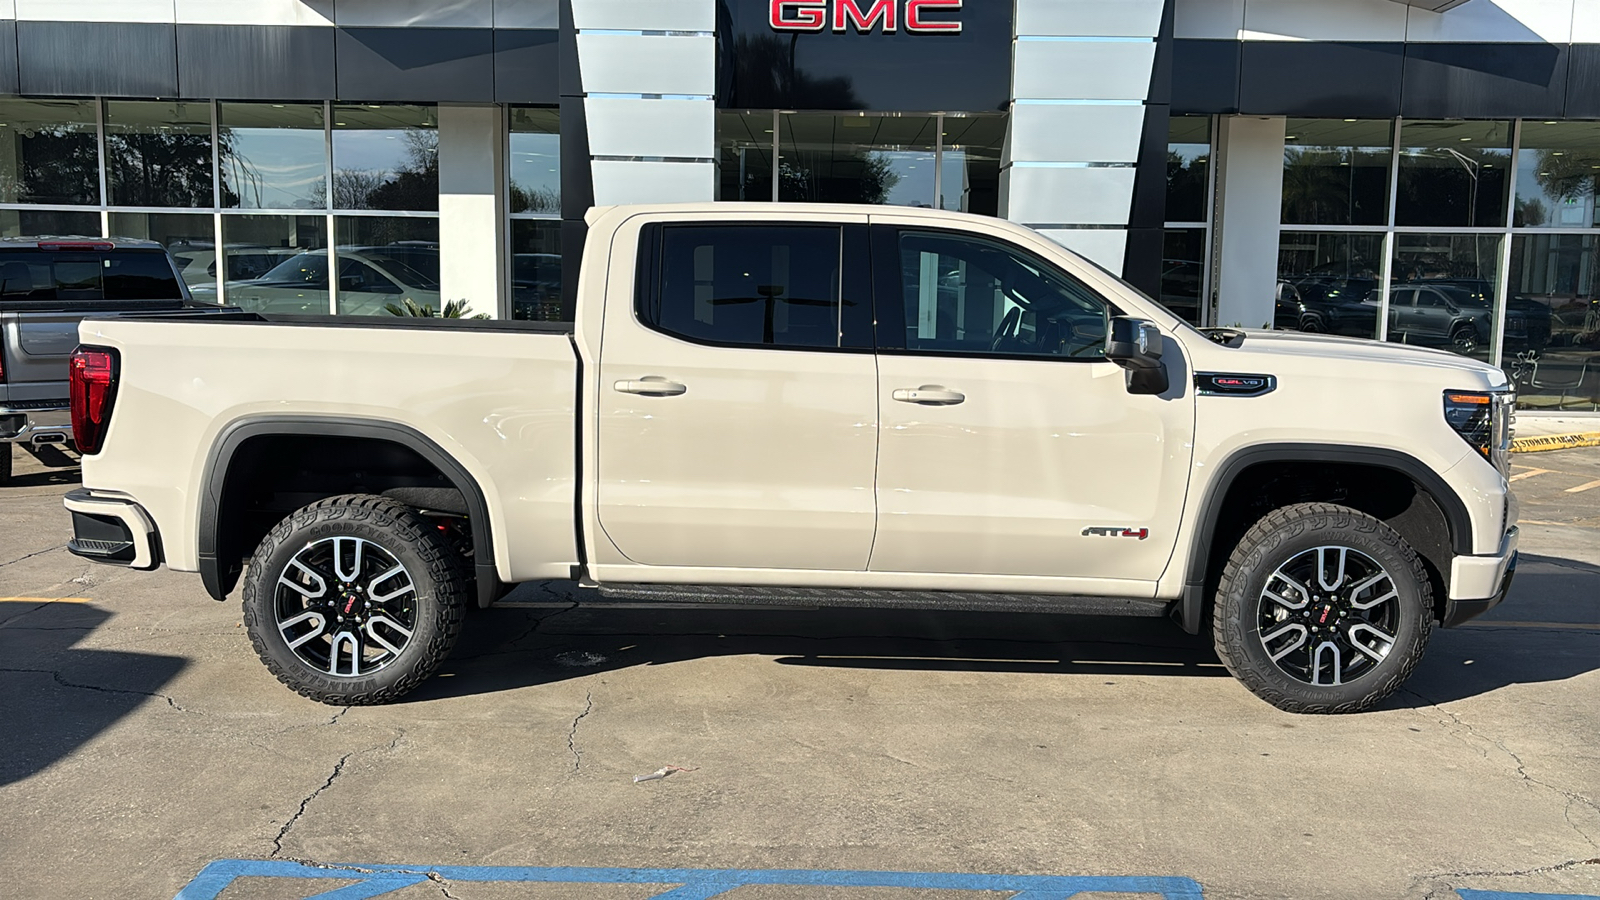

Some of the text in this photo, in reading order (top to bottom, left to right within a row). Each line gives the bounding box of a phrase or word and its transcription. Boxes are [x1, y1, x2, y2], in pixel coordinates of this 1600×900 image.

[769, 0, 963, 32] GMC
[1513, 438, 1551, 448] USTOMER
[310, 522, 407, 555] GOODYEAR
[1081, 526, 1149, 541] AT4
[1320, 532, 1402, 572] WRANGLER
[344, 595, 356, 613] GMC
[1319, 604, 1330, 623] GMC
[288, 662, 378, 691] WRANGLER
[1256, 657, 1345, 700] GOODYEAR
